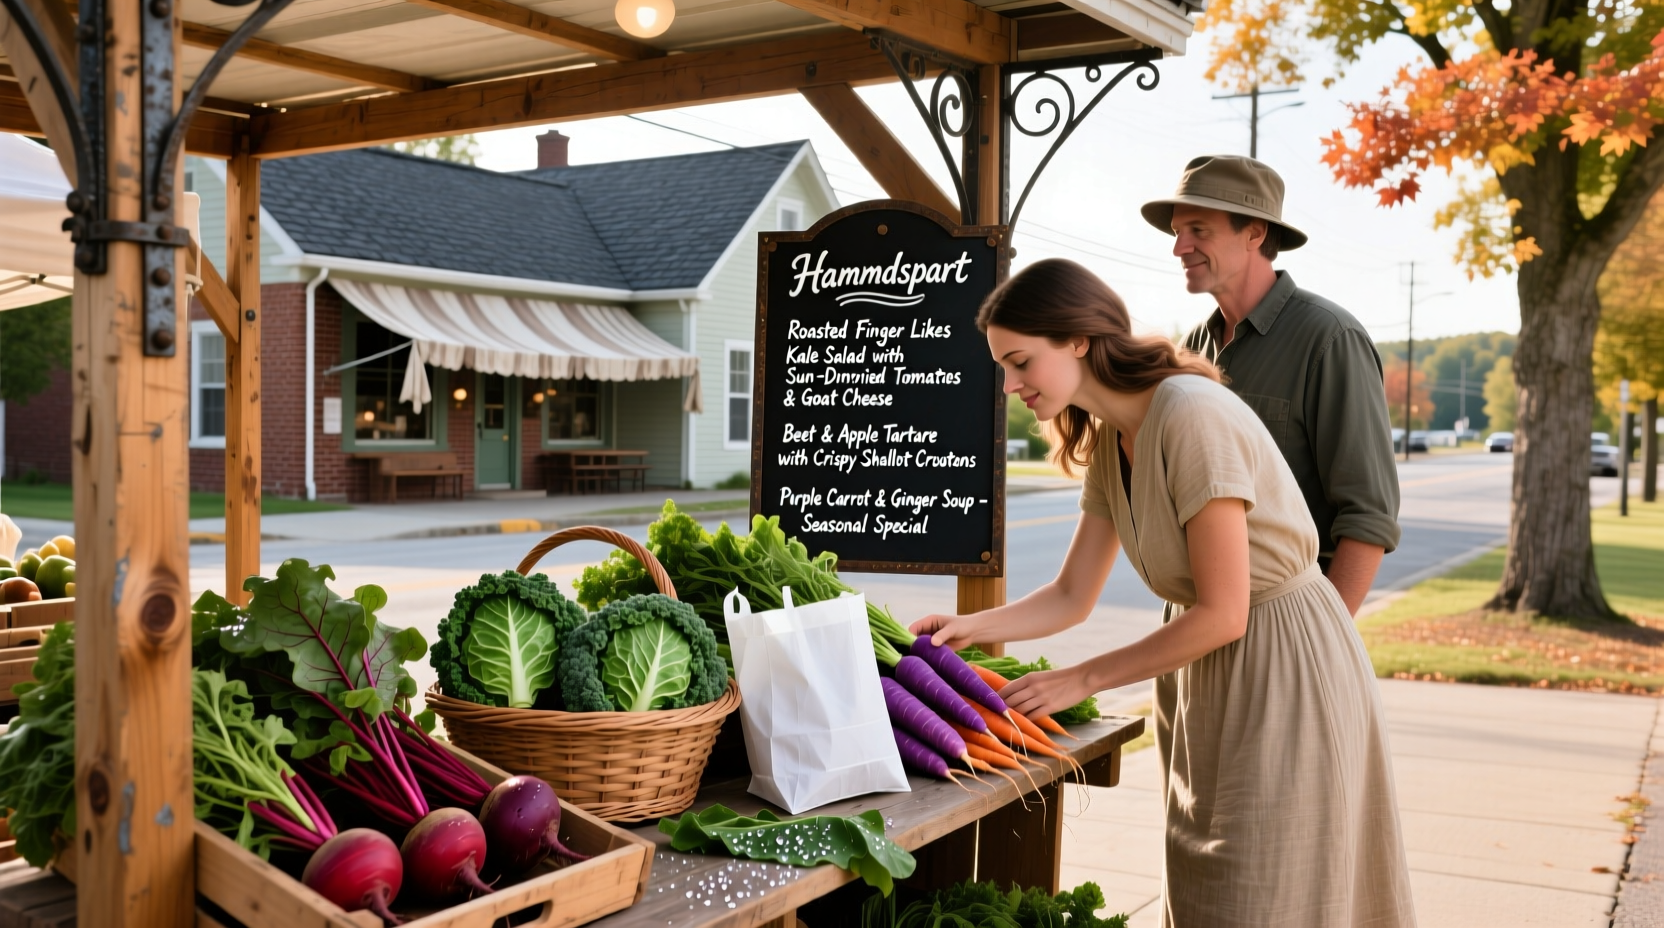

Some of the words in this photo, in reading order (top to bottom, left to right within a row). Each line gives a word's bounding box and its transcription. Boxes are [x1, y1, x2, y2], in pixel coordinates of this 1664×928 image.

[787, 319, 849, 340] Roasted
[855, 318, 905, 348] Finger
[910, 317, 952, 339] Likes
[786, 345, 819, 364] Kale
[823, 345, 866, 365] Salad
[872, 345, 905, 364] with
[783, 389, 796, 407] &
[801, 388, 839, 407] Goat
[842, 387, 893, 407] Cheese
[782, 423, 817, 443] Beet
[820, 424, 834, 443] &
[837, 423, 879, 450] Apple
[883, 423, 938, 444] Tartare
[777, 449, 809, 467] with
[813, 448, 858, 474] Crispy
[859, 448, 913, 468] Shallot
[826, 487, 872, 507] Carrot
[874, 488, 887, 508] &
[890, 488, 938, 515] Ginger
[941, 488, 975, 515] Soup
[800, 513, 869, 533] Seasonal
[873, 514, 929, 540] Special
